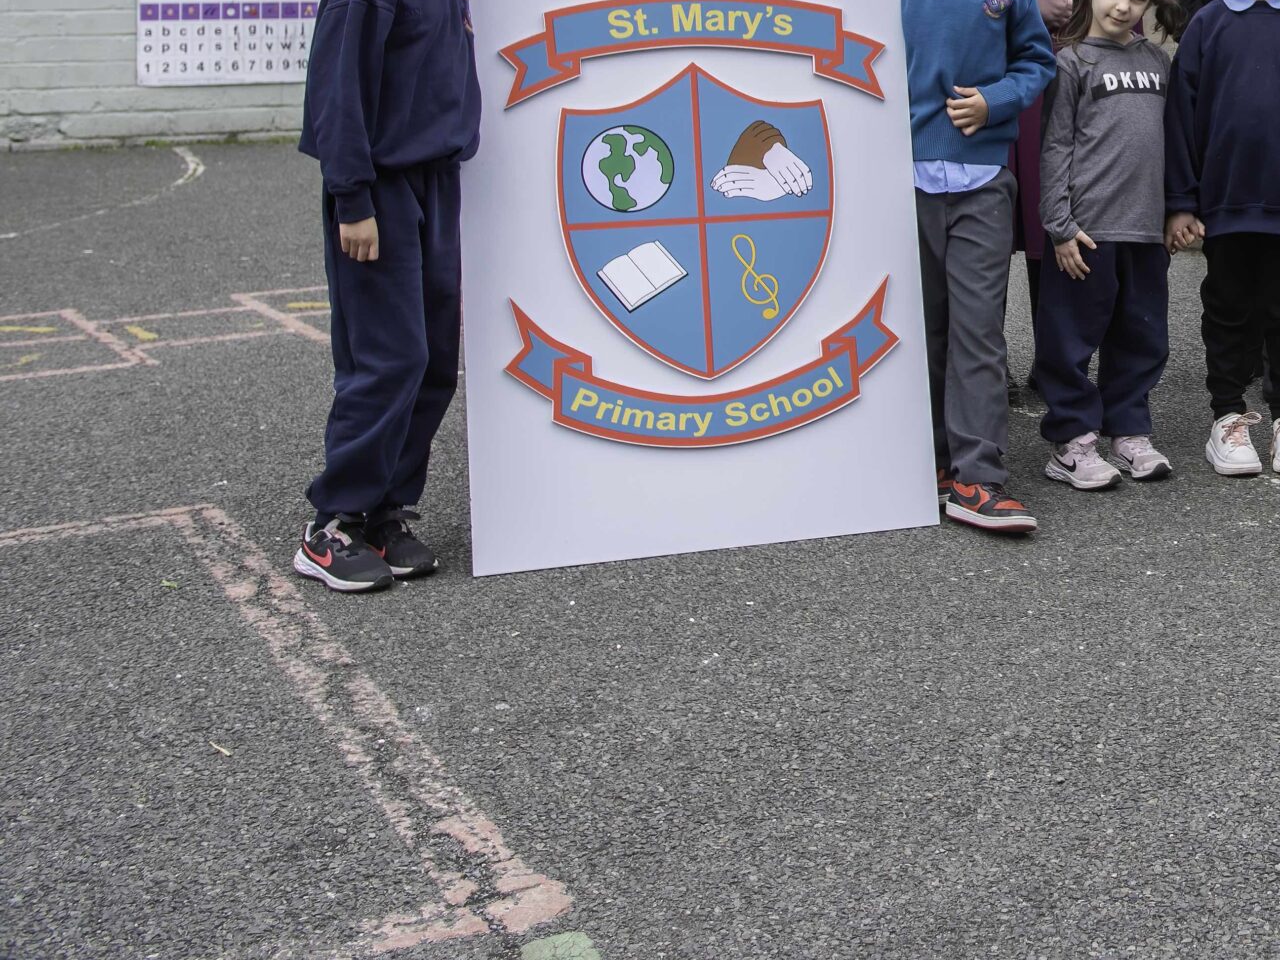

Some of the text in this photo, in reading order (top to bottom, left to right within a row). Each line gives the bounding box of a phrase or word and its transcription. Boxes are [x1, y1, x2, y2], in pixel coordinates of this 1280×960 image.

[607, 3, 793, 40] St. Mary's
[1103, 71, 1160, 91] DKNY
[570, 366, 844, 438] Primary School
